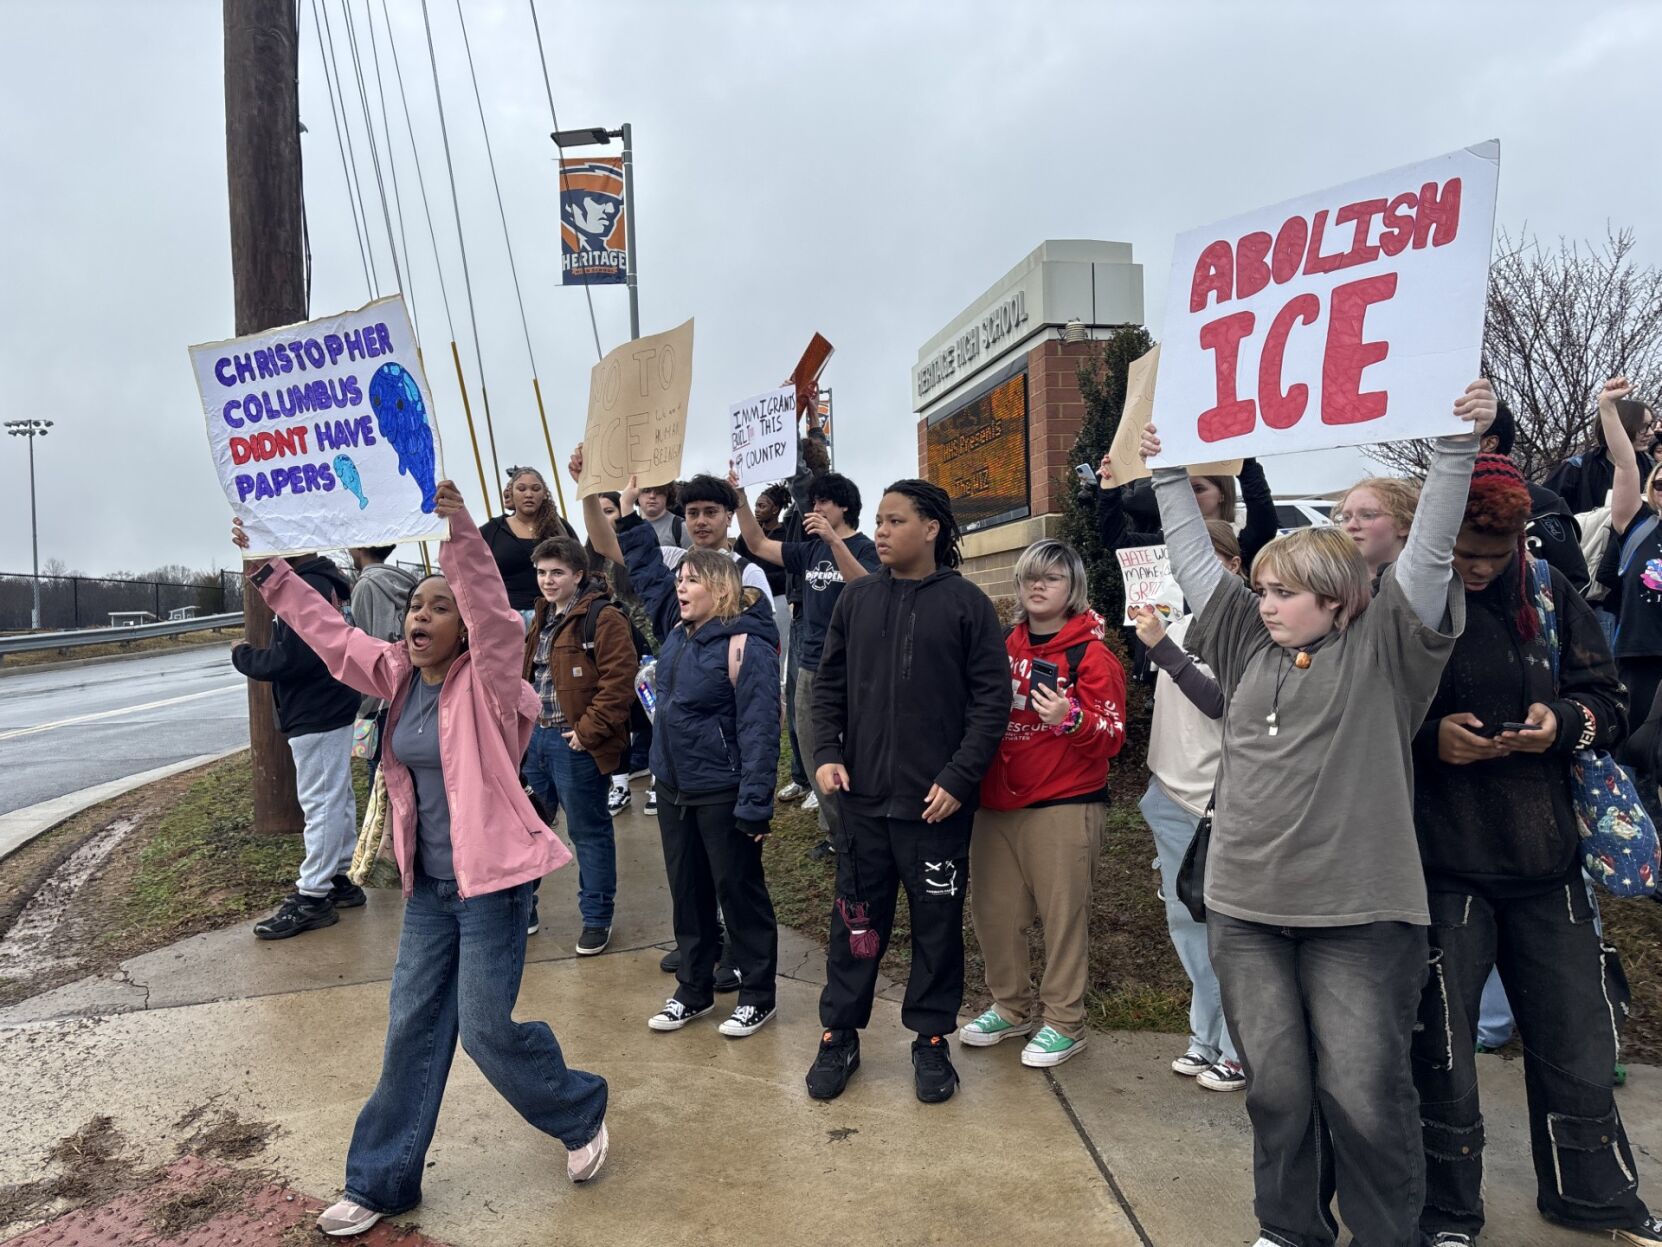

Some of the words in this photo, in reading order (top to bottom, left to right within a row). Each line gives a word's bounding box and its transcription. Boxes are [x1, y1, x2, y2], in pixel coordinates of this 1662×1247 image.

[562, 251, 626, 271] HERITAGE
[1189, 176, 1462, 313] ABOLISH
[214, 322, 394, 387] CHRISTOPHER
[917, 345, 955, 396] HERITAGE
[956, 325, 980, 368] HIGH
[982, 290, 1029, 349] SCHOOL
[1197, 271, 1398, 443] ICE
[632, 344, 676, 397] TO
[223, 375, 363, 429] COLUMBUS
[733, 392, 796, 430] IMMIGRANTS
[760, 415, 783, 436] THIS
[229, 425, 308, 465] DIDNT
[314, 414, 377, 451] HAVE
[582, 411, 652, 488] ICE
[745, 441, 787, 469] COUNTRY
[235, 462, 336, 503] PAPERS
[1118, 550, 1153, 567] HATE
[1007, 721, 1049, 732] ESCUE
